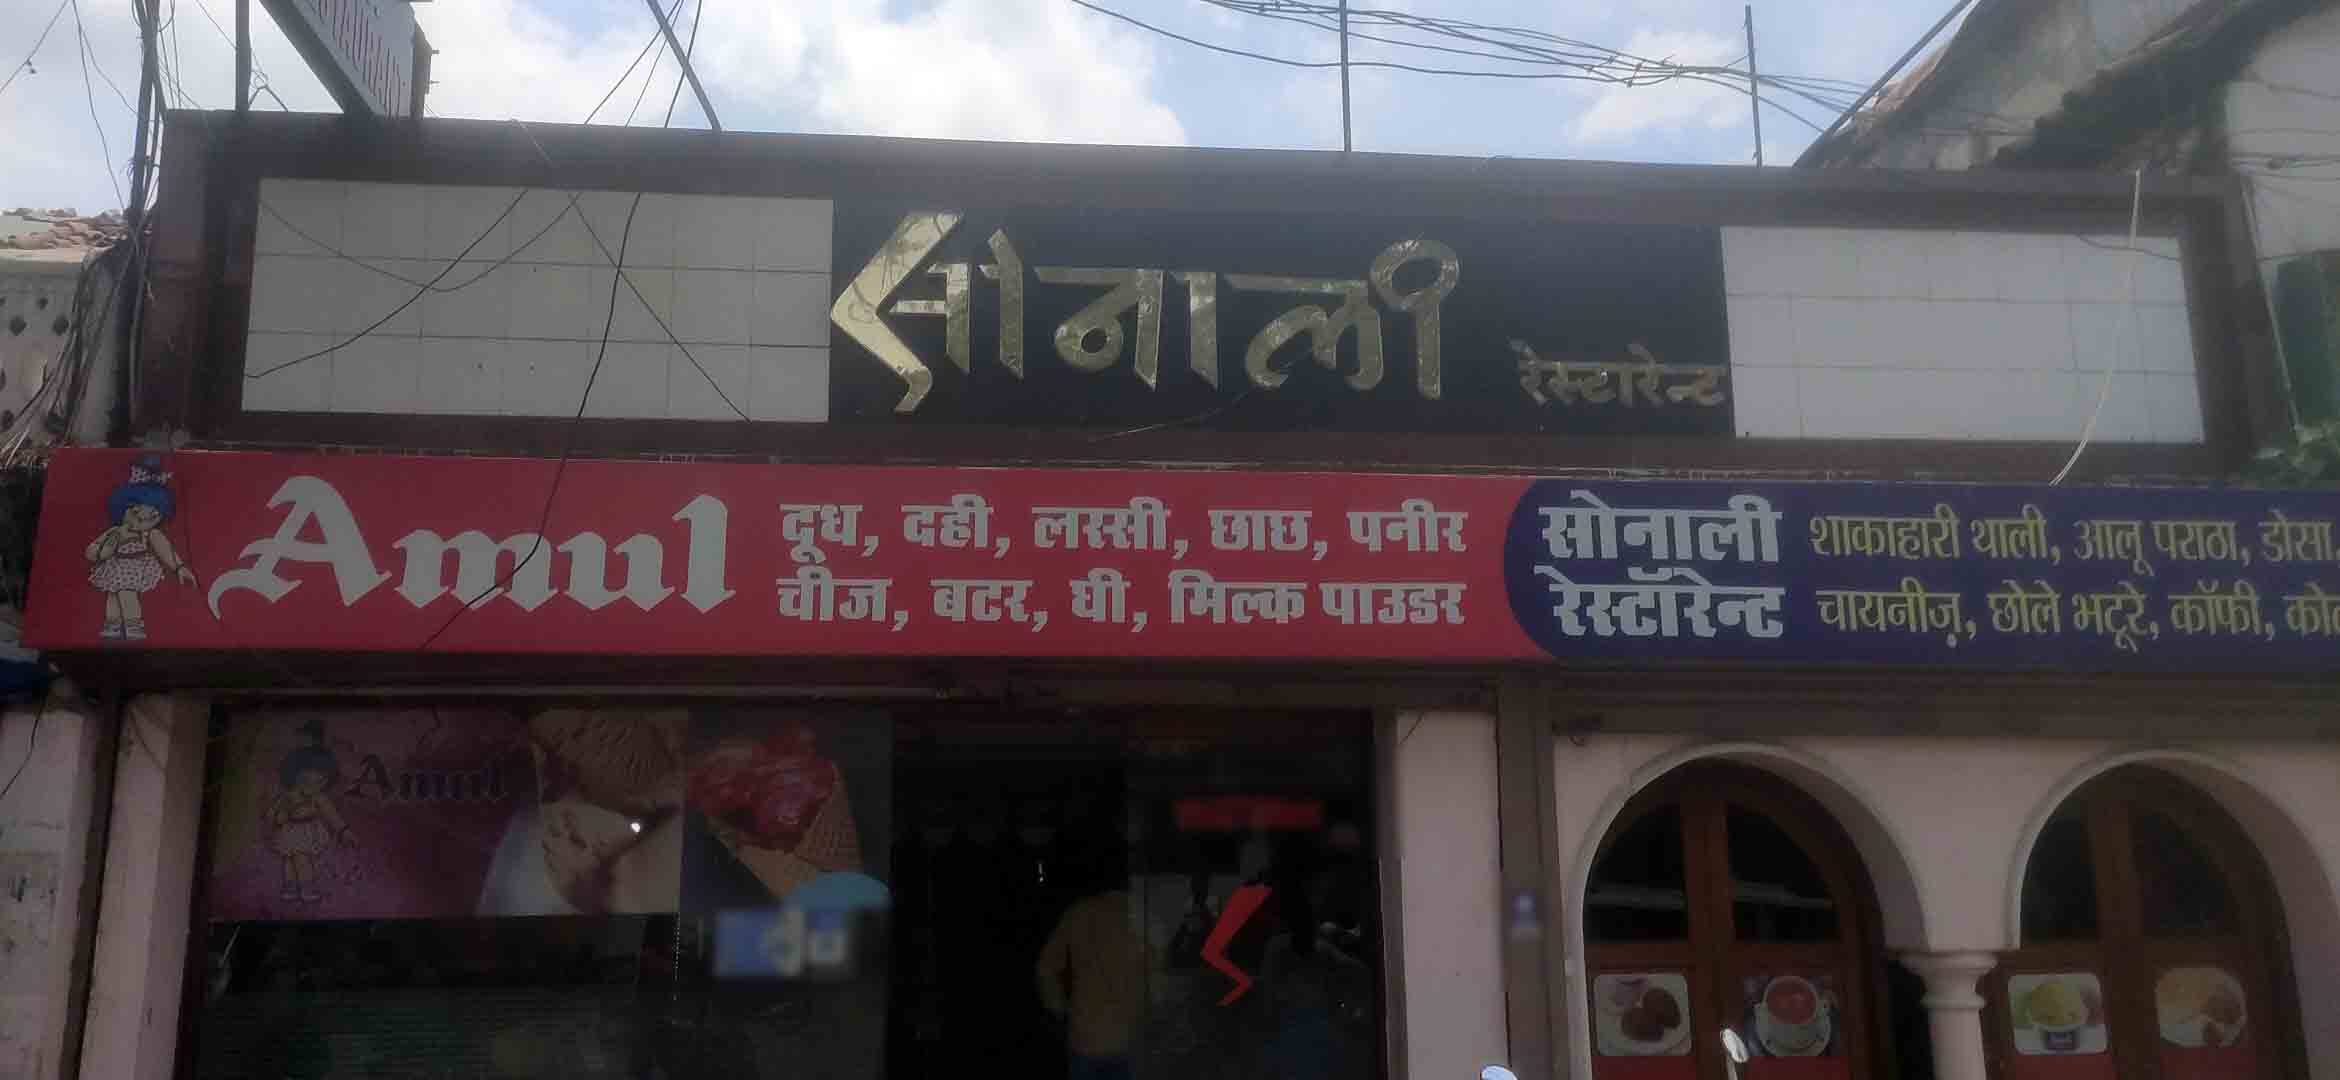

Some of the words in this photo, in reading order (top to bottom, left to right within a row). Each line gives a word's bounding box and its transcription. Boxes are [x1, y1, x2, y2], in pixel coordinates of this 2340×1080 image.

[830, 212, 1460, 412] सोनाली
[208, 475, 736, 619] Amul
[779, 503, 879, 563] दूध,
[901, 494, 1010, 558] दही,
[1031, 496, 1189, 560] लस्सी,
[1207, 509, 1328, 561] छाछ,
[1346, 498, 1469, 553] पनीर
[1538, 489, 1783, 563] सोनाली
[1809, 503, 1961, 560] शाकाहारी
[1970, 503, 2061, 565] थाली,
[2073, 519, 2153, 577] आलू
[2152, 519, 2250, 567] पराठा,
[775, 565, 909, 632] चीज,
[930, 579, 1048, 633] बटर,
[1069, 567, 1147, 633] घी,
[1167, 568, 1307, 624] मिल्क
[1319, 582, 1467, 625] पाउडर
[1533, 565, 1786, 638] रेस्टॉरेन्ट
[1986, 578, 2061, 634] छोले
[2071, 580, 2160, 653] भटूरे,
[2167, 578, 2275, 641] कॉफी,
